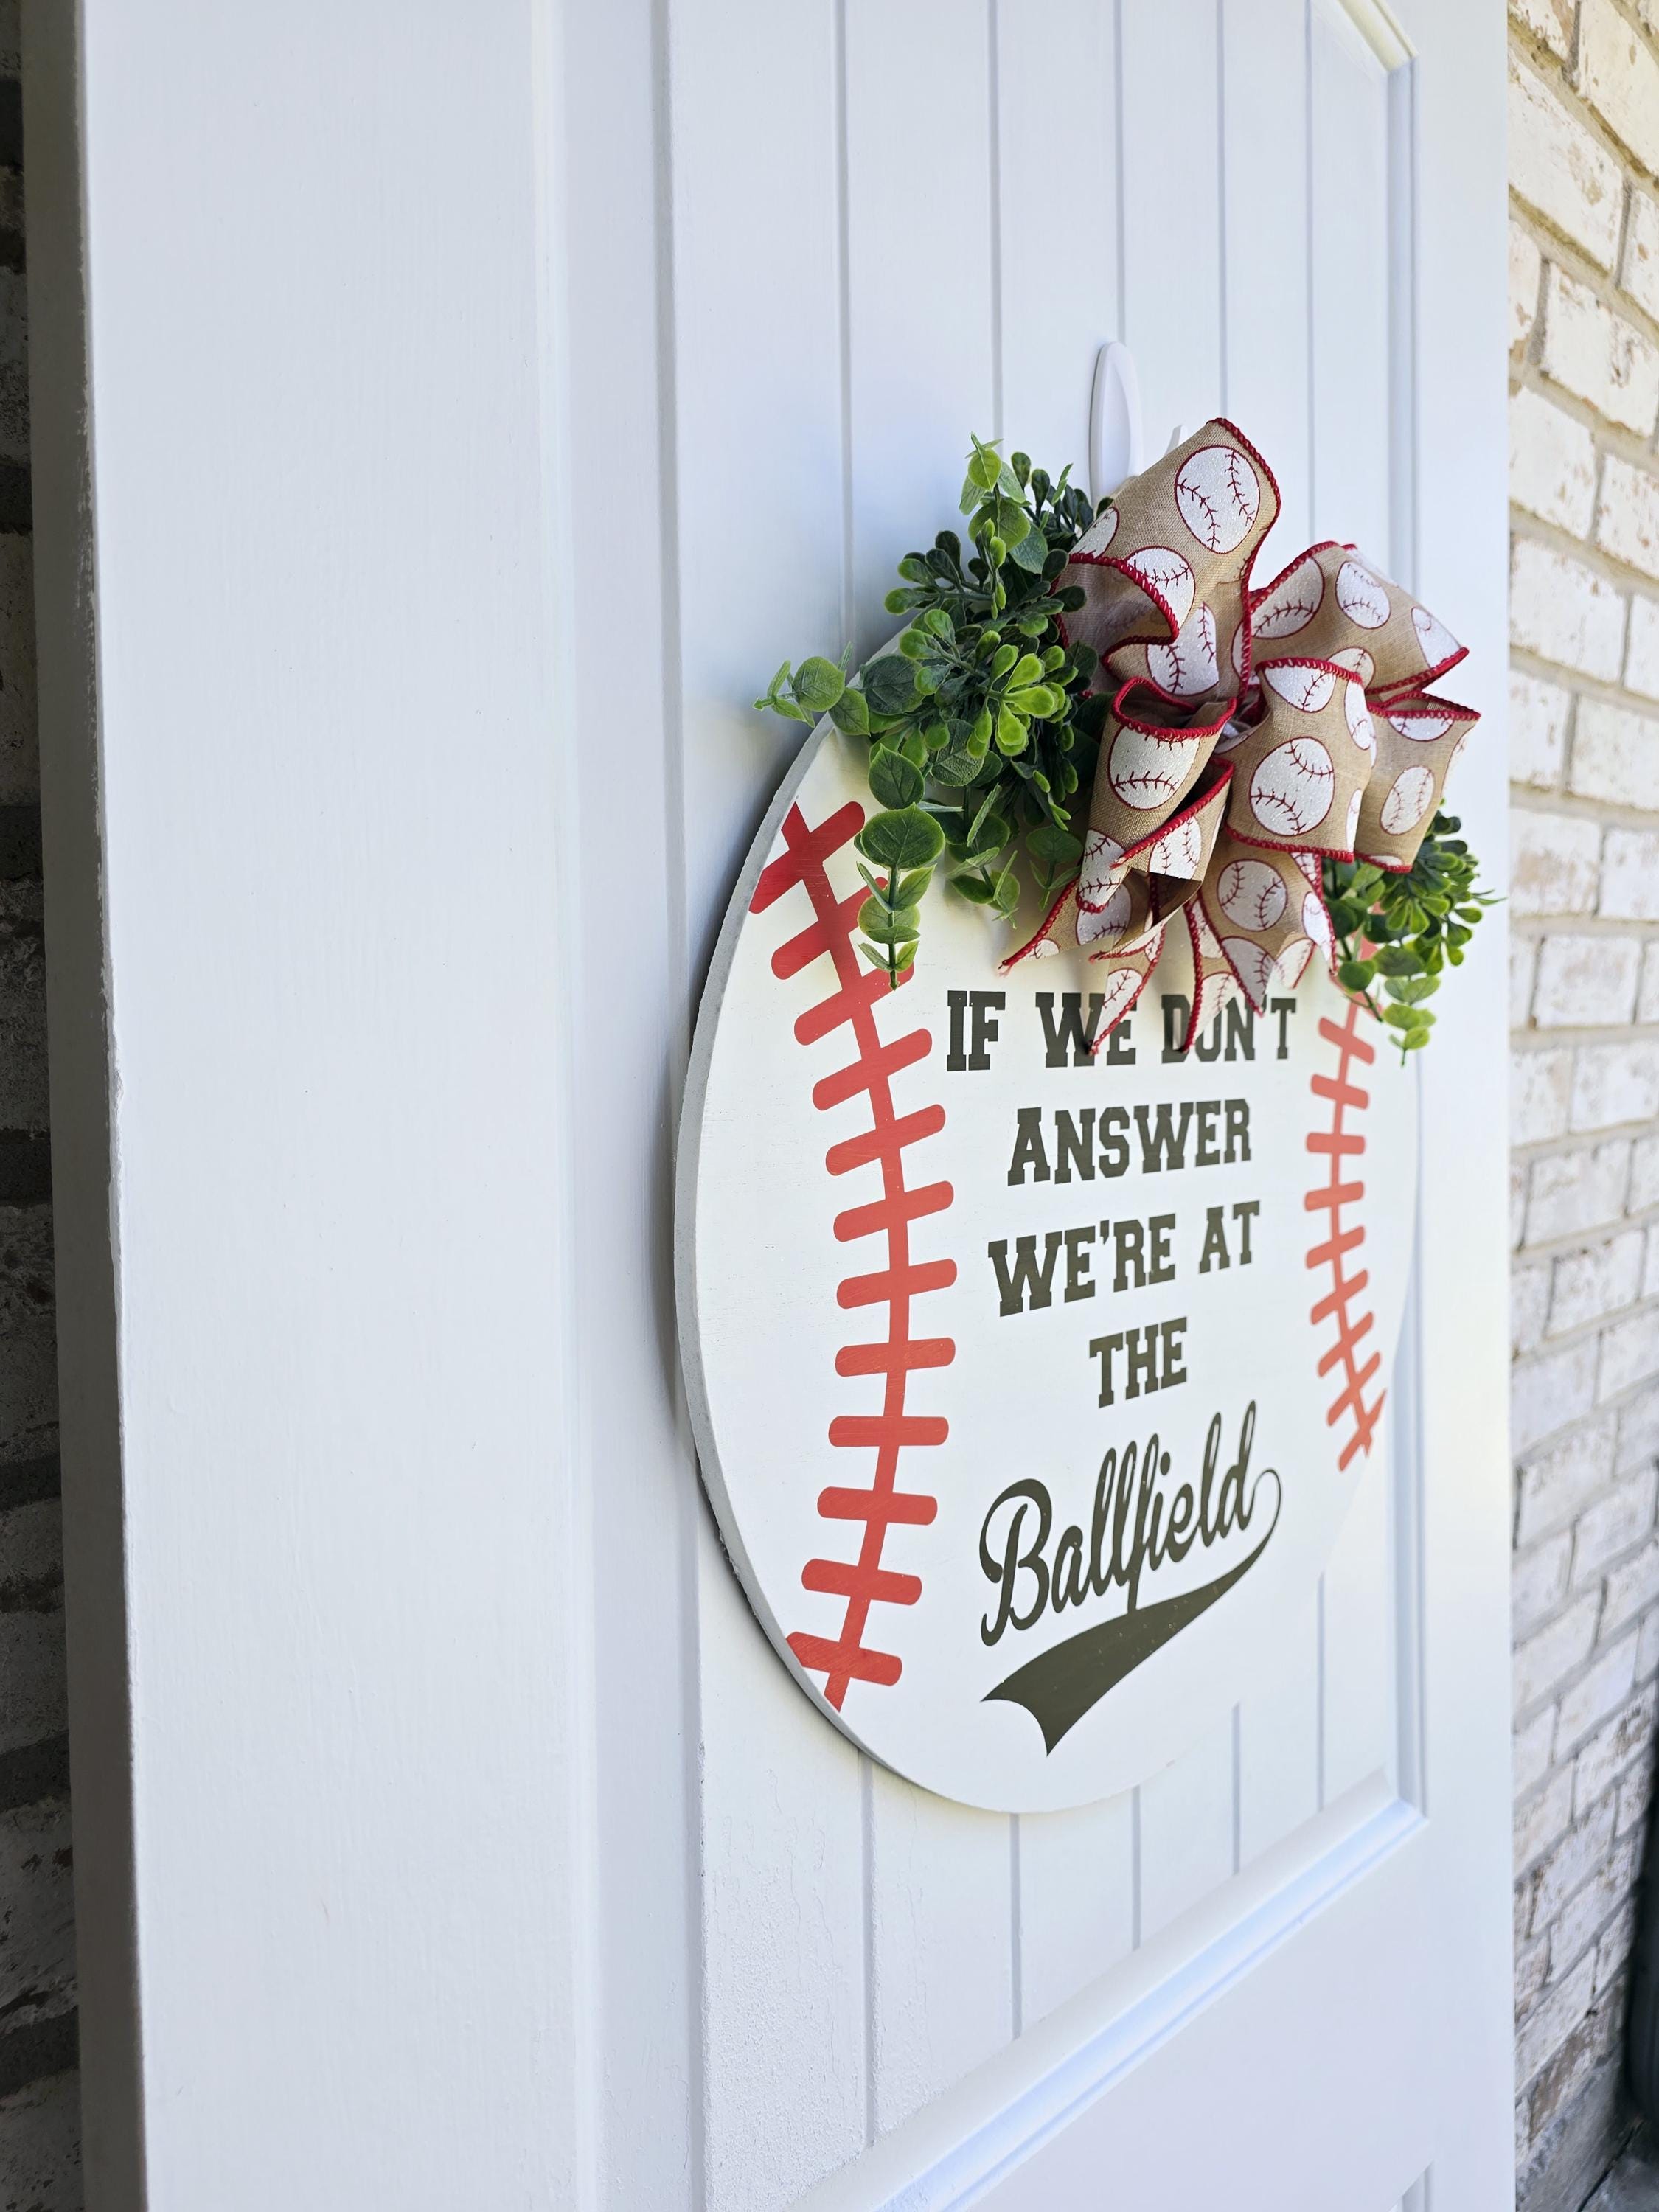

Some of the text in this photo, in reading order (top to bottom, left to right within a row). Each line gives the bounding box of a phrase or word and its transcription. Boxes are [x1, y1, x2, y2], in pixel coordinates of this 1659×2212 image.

[947, 990, 1006, 1071] IF
[1035, 992, 1136, 1068] WE
[1007, 1099, 1252, 1186] ANSWER
[988, 1200, 1259, 1317] WE'RE AT
[1089, 1317, 1188, 1408] THE
[979, 1399, 1281, 1646] Ballfield
